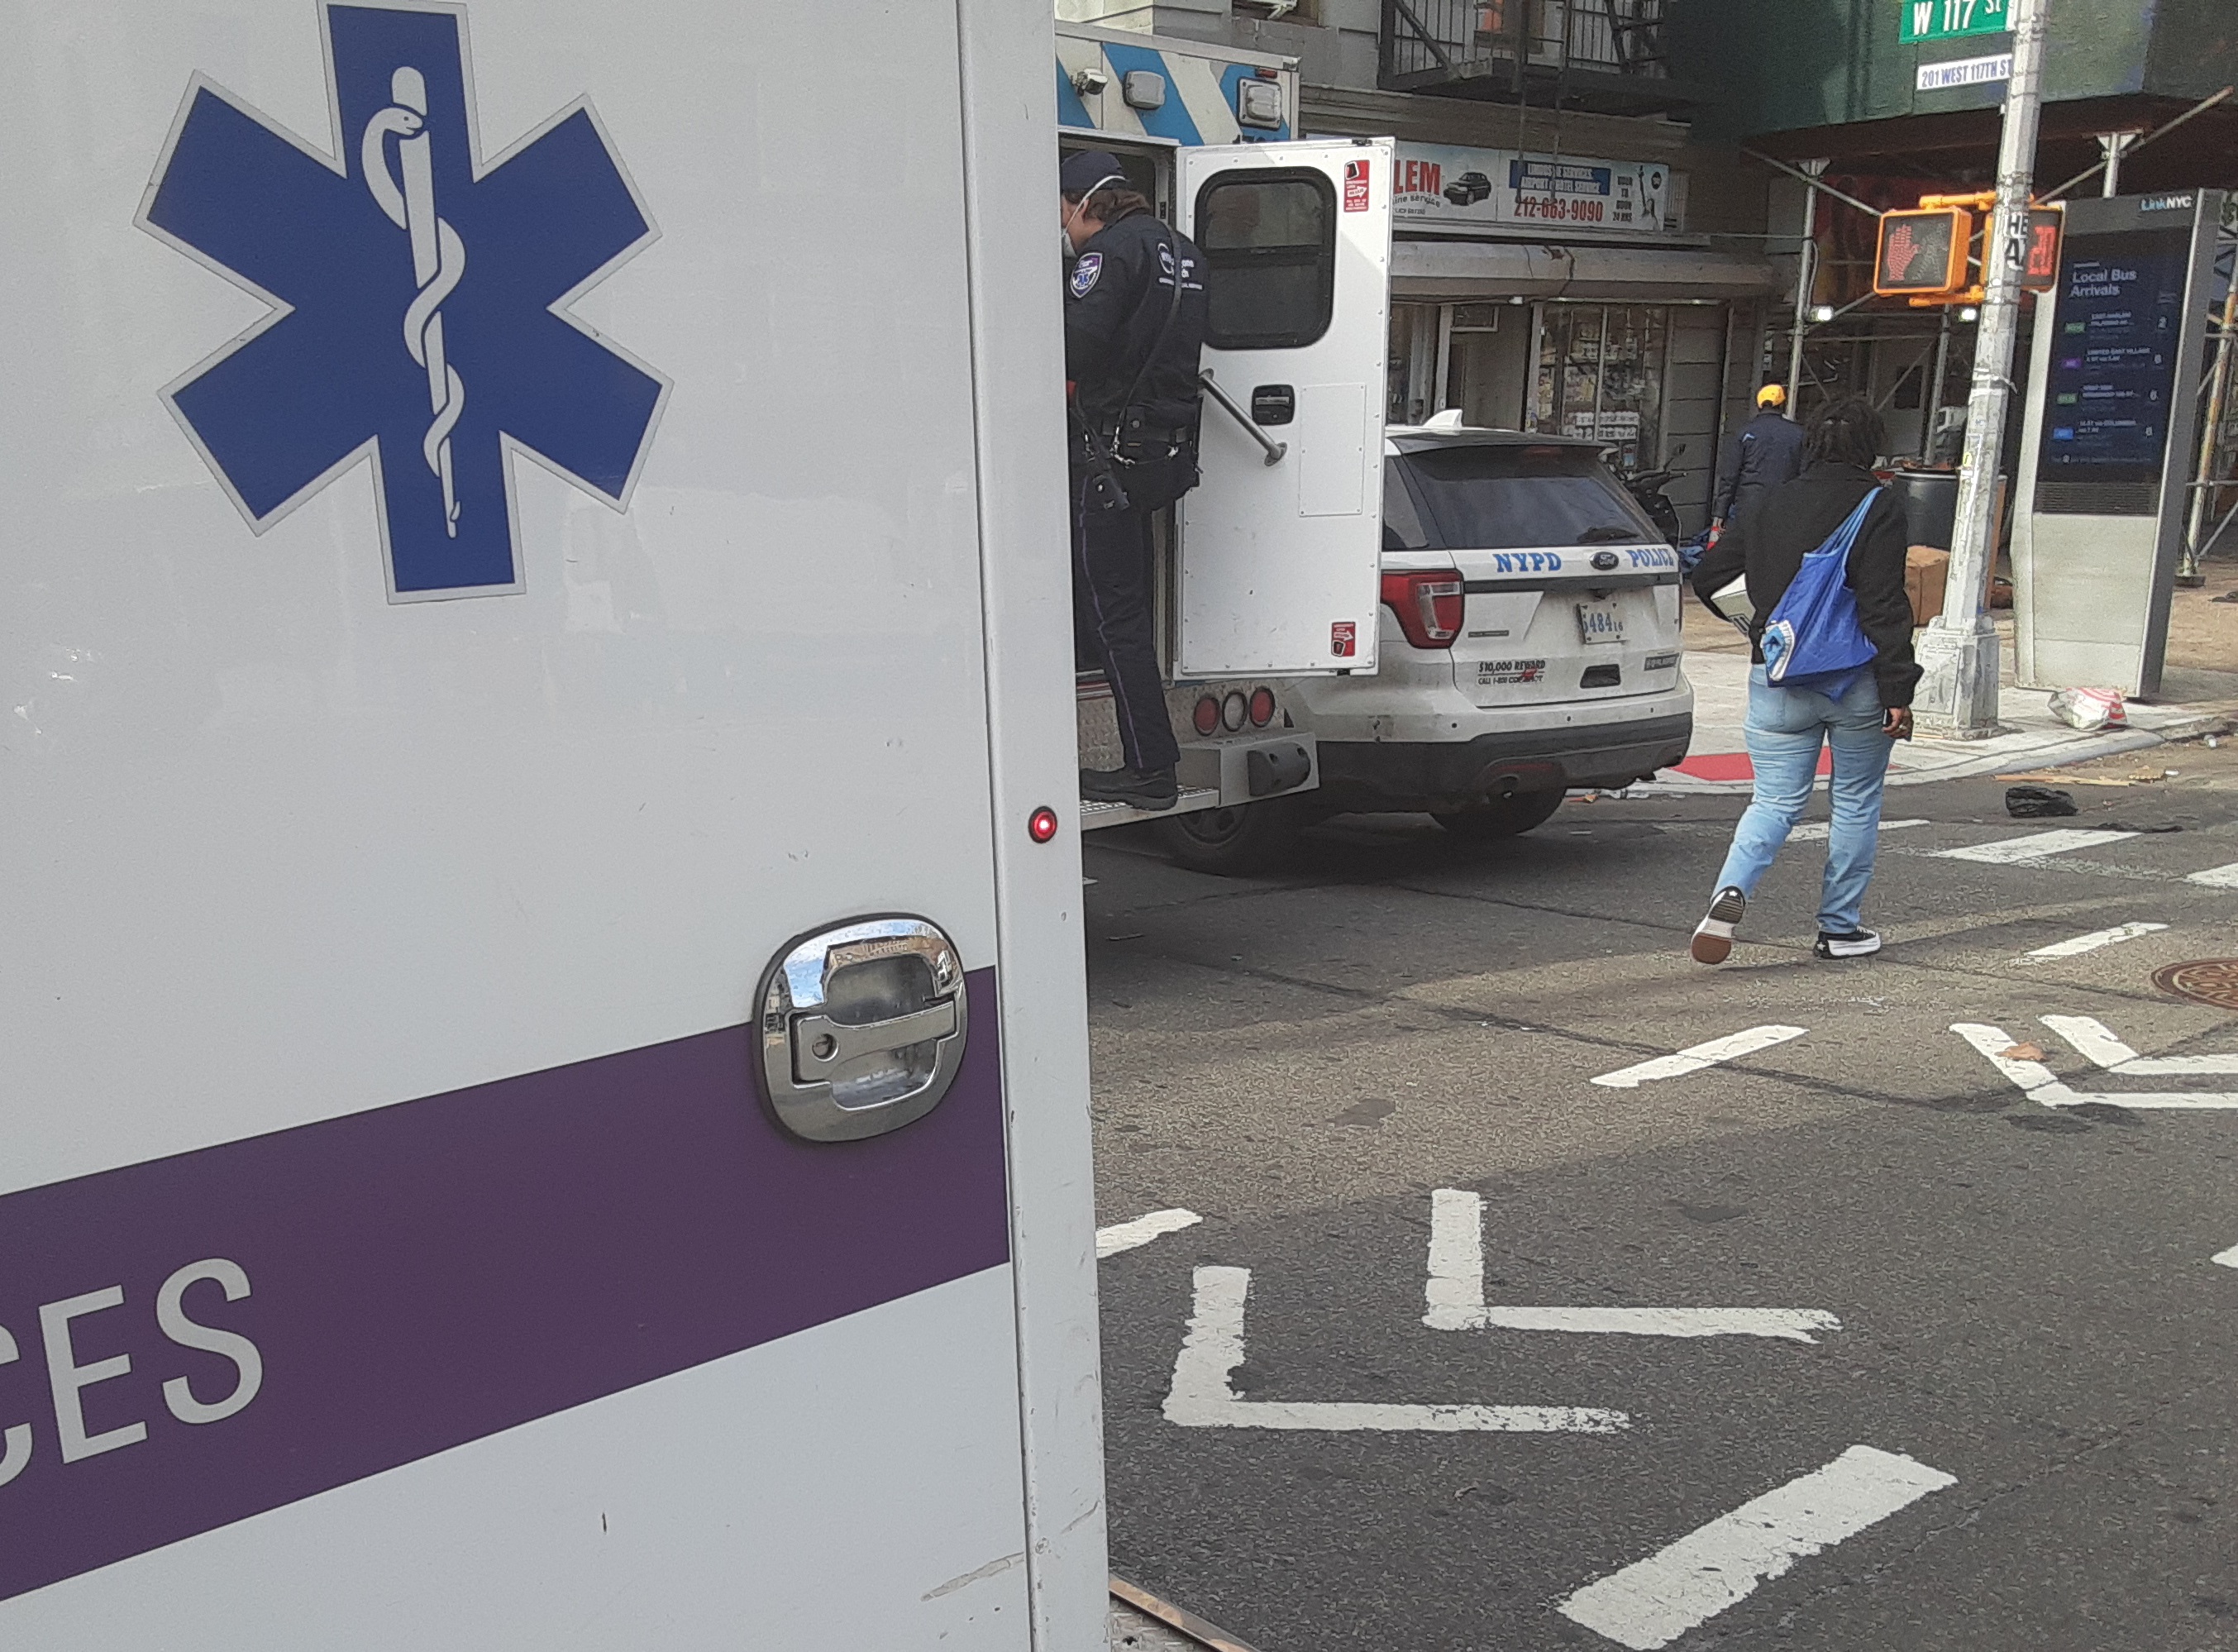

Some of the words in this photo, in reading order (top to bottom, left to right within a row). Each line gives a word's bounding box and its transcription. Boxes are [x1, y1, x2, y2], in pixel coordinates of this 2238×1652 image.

[1913, 1, 1934, 36] W
[1943, 0, 1977, 31] 117
[1921, 70, 1940, 88] 201
[1941, 65, 1969, 84] WEST
[1971, 60, 1998, 81] 117TH
[2000, 59, 2013, 76] ST
[2140, 195, 2193, 212] LinkNYC
[2072, 269, 2107, 284] Local
[2111, 268, 2137, 282] Bus
[2069, 283, 2121, 298] Arrivals
[1492, 551, 1562, 572] NYPD
[1625, 548, 1674, 568] POLICE
[1478, 661, 1512, 674] $10,000
[1514, 660, 1546, 671] REWARD
